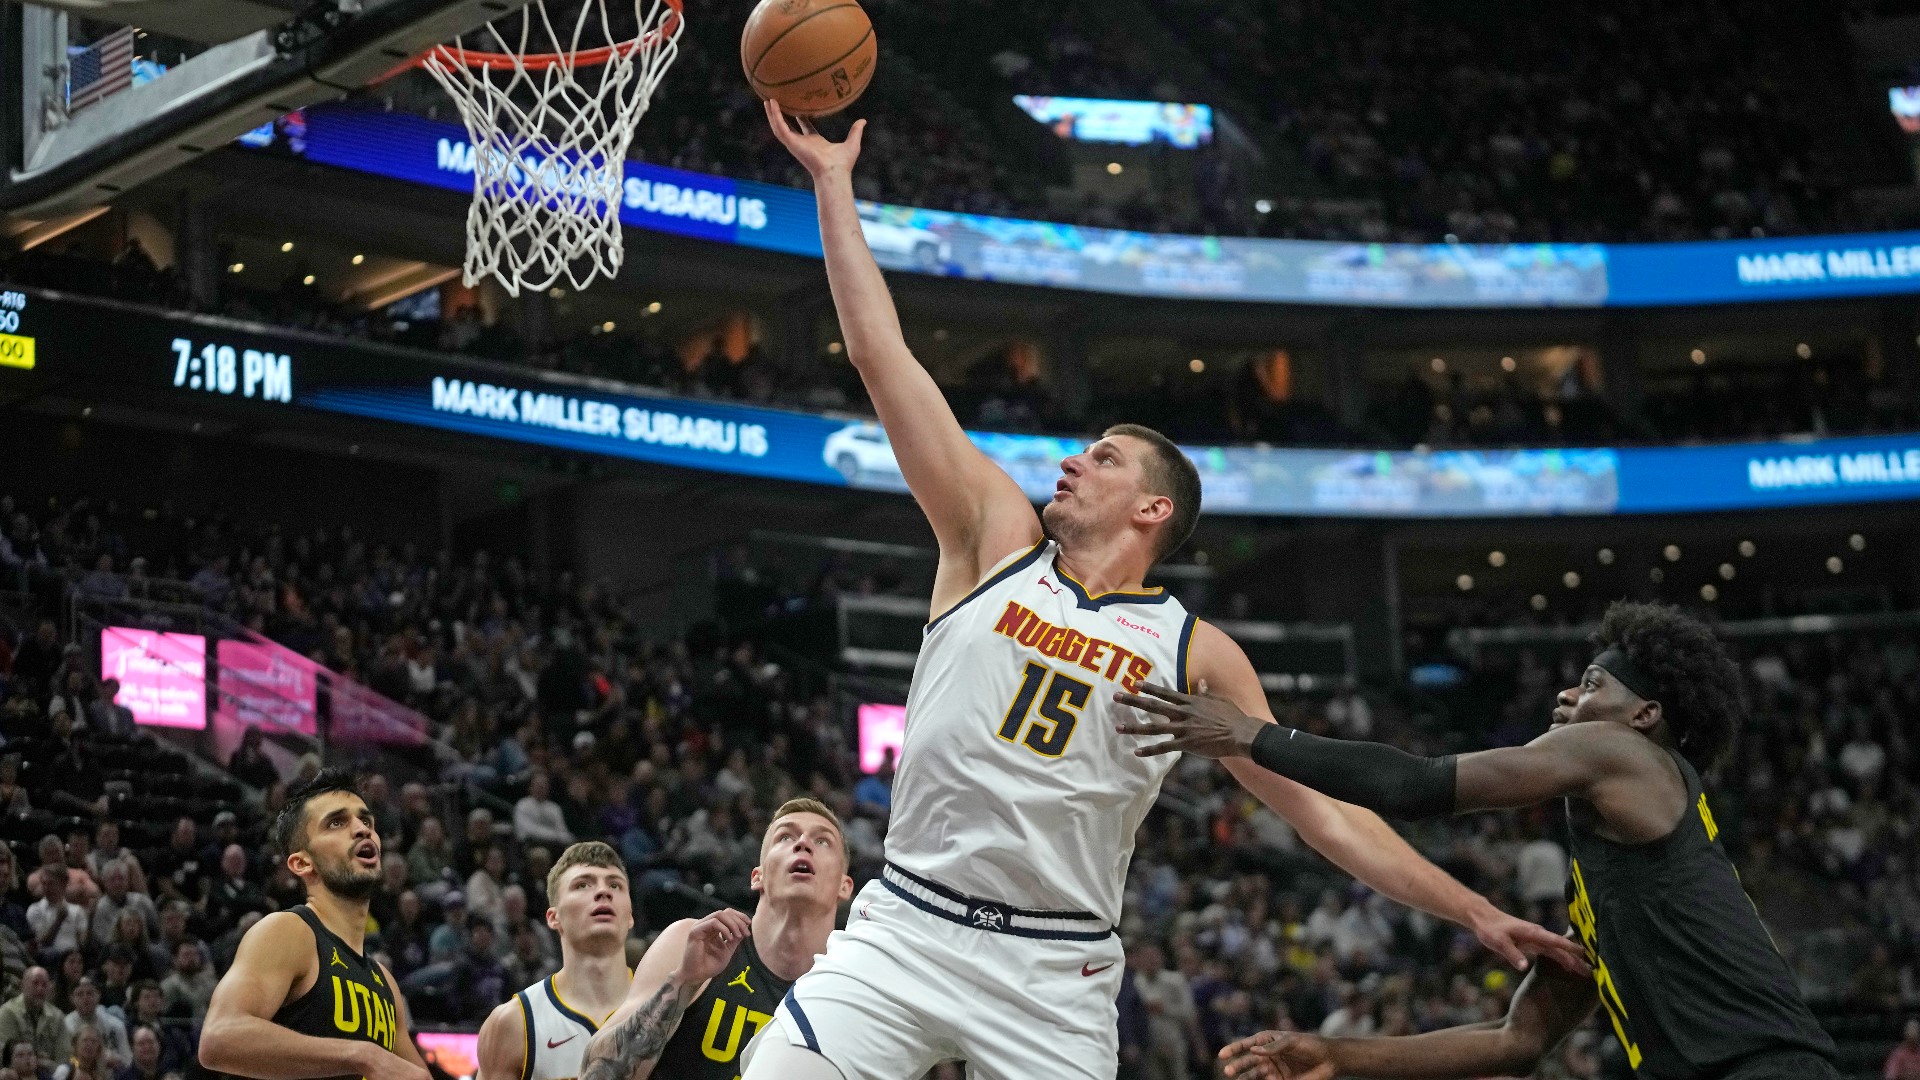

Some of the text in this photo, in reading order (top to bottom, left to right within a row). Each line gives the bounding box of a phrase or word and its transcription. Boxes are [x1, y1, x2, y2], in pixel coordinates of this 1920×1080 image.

[624, 177, 736, 225] SUBARU
[738, 197, 767, 229] IS
[1737, 253, 1826, 283] MARK
[171, 337, 291, 403] 7:18 PM
[432, 376, 768, 457] MARK MILLER SUBARU IS
[1749, 454, 1837, 490] MARK
[993, 600, 1153, 695] NUGGETS
[1115, 615, 1160, 639] ibotta
[996, 660, 1095, 758] 15
[331, 975, 396, 1053] UTAH
